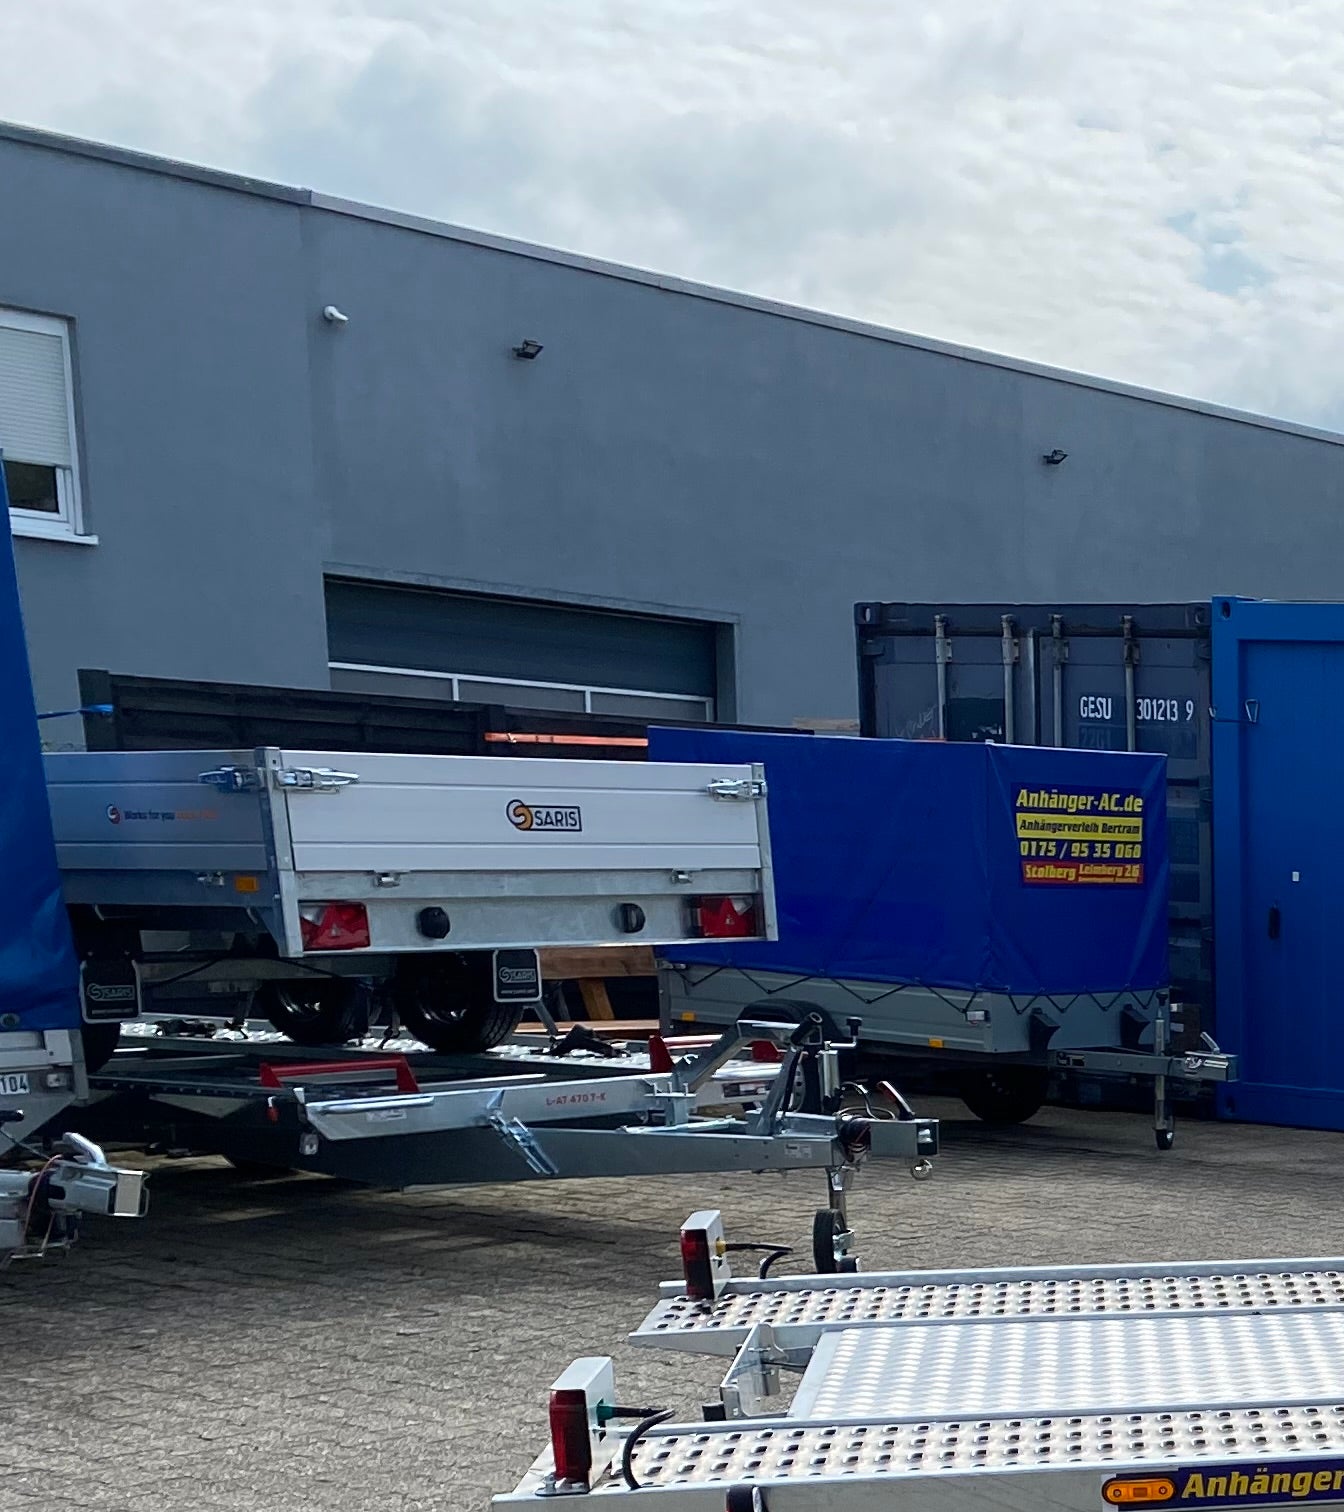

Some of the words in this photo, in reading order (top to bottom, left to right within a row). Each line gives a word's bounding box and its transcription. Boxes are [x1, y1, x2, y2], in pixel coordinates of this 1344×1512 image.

[1080, 696, 1112, 720] GESU
[1136, 698, 1178, 721] 301213
[1185, 700, 1195, 721] 9
[1016, 789, 1143, 812] Anhänger-AC.de
[534, 810, 578, 827] SARIS
[1019, 819, 1099, 834] Anhängerverleih
[1102, 823, 1140, 835] Bertram
[1020, 841, 1056, 857] 0175
[1071, 843, 1089, 857] 95
[1093, 843, 1111, 858] 35
[1026, 865, 1077, 880] Stolberg
